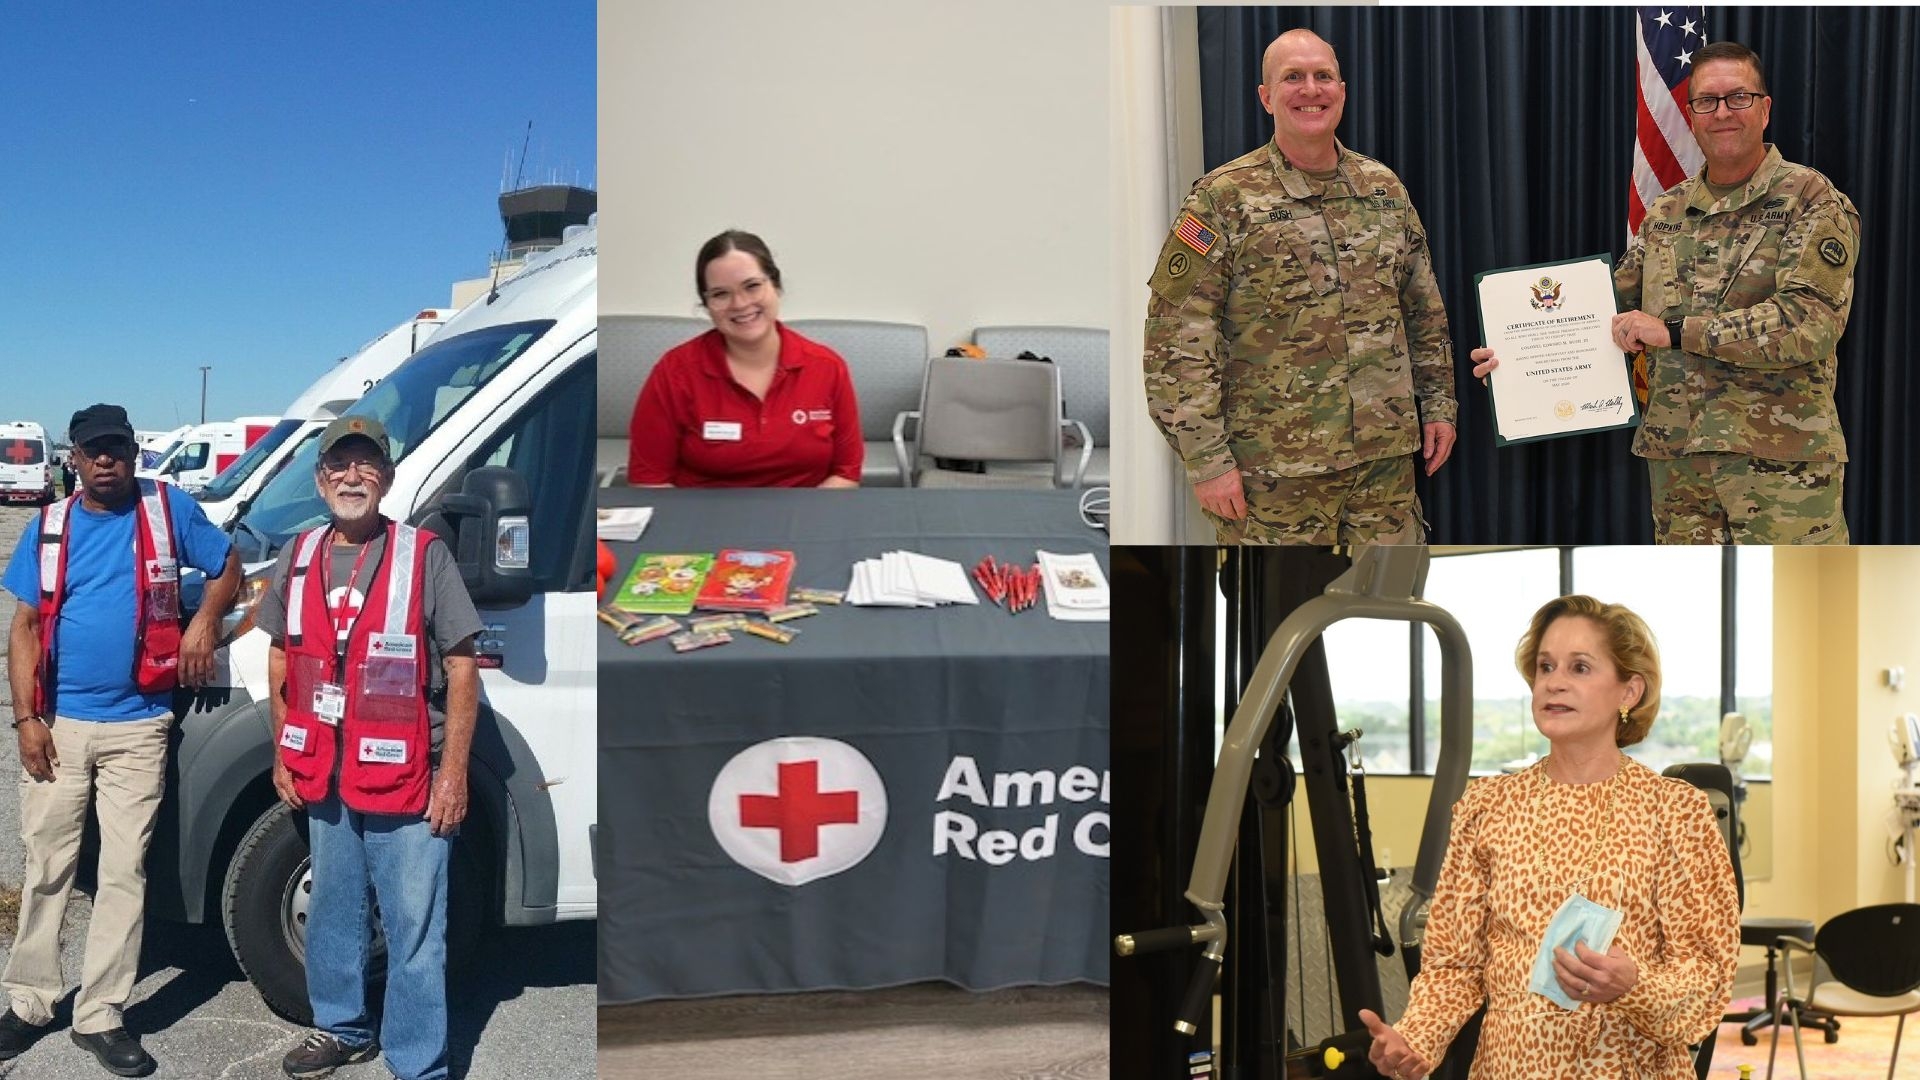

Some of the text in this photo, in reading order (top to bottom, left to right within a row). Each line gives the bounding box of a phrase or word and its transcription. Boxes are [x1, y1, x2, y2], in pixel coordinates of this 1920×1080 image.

[1268, 209, 1292, 220] BUSH
[1764, 211, 1790, 221] ARMY
[1652, 221, 1682, 232] HOPKINS
[1506, 319, 1546, 330] CERTIFICATE
[1546, 318, 1555, 326] OF
[1556, 314, 1596, 324] RETIREMENT
[1525, 363, 1592, 377] UNITED STATES ARMY
[933, 811, 1059, 865] Red
